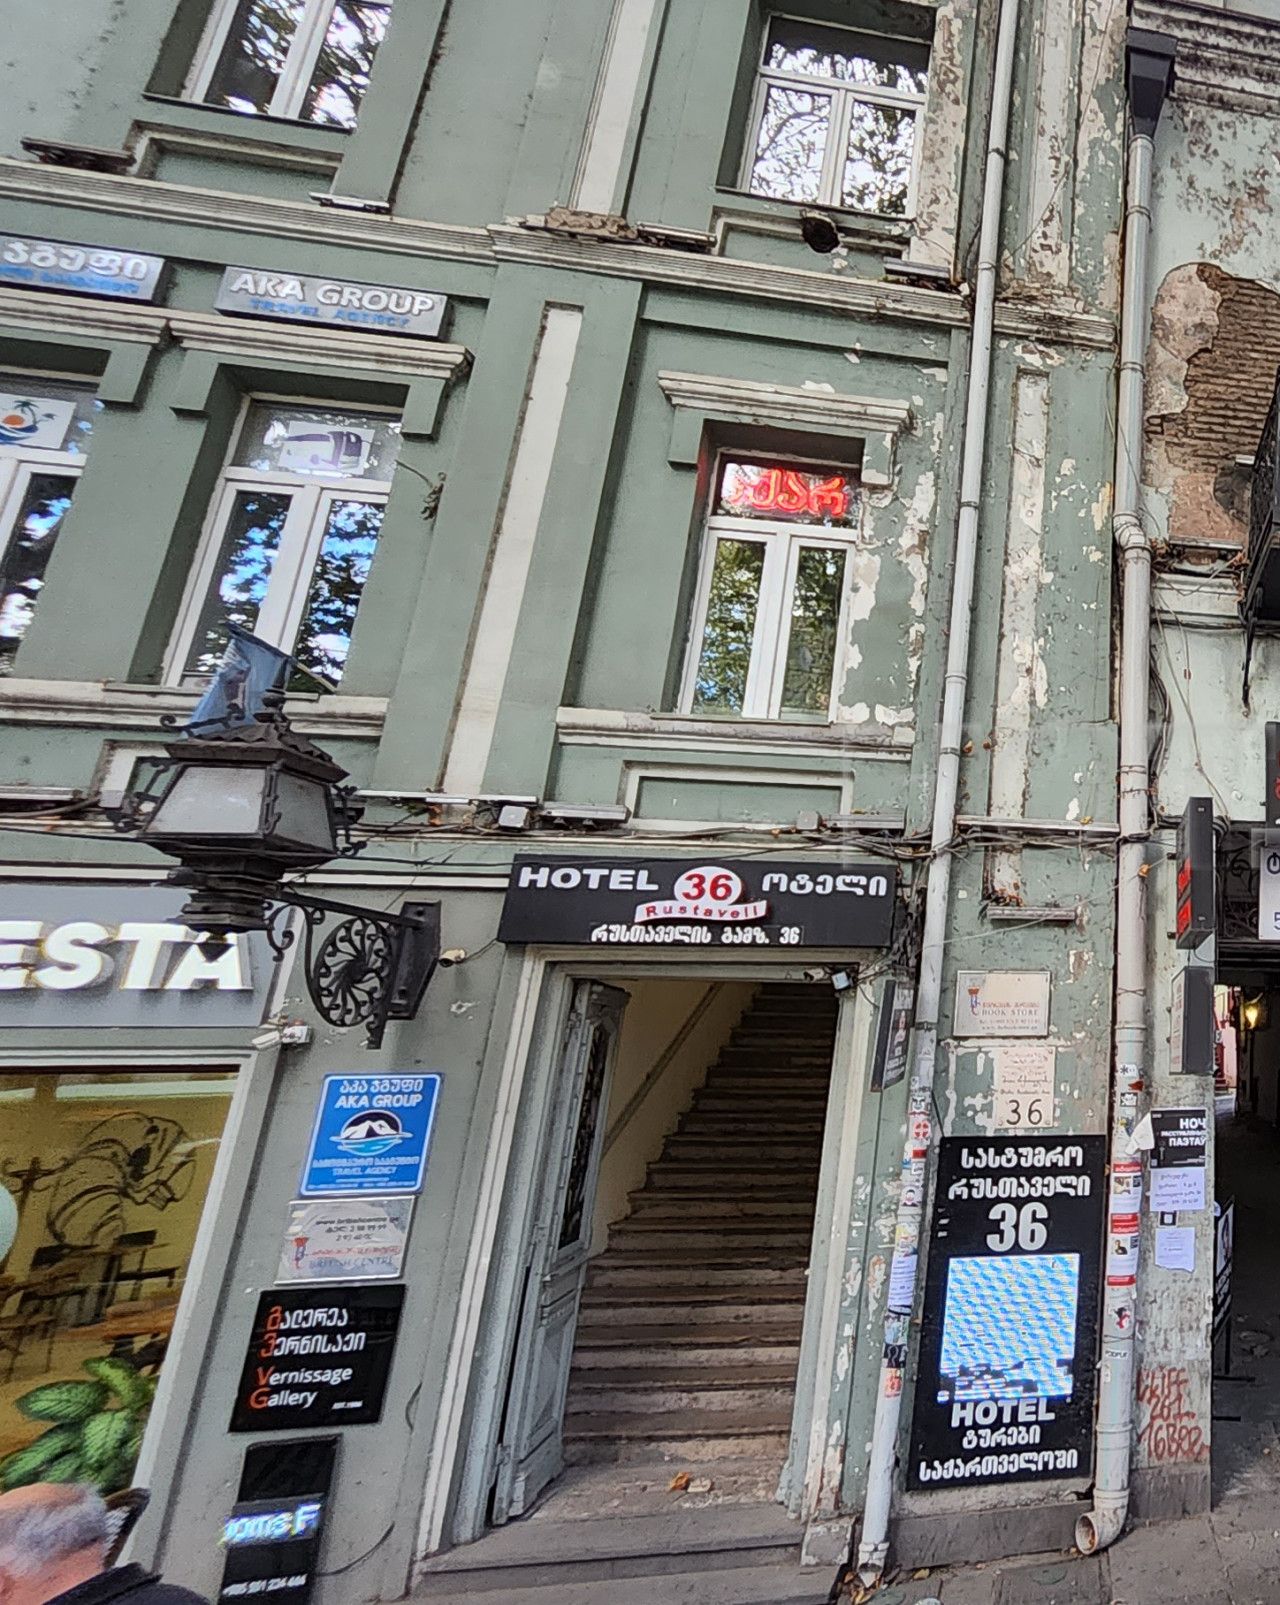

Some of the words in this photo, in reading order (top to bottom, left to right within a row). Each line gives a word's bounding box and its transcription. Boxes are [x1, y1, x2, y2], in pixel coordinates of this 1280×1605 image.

[230, 273, 305, 301] AKA
[316, 284, 435, 317] GROUP
[518, 866, 660, 891] HOTEL
[682, 872, 734, 902] 36
[761, 871, 889, 898] ოტელი
[645, 903, 760, 920] Rustaveli
[590, 923, 712, 945] რუსთაველის
[721, 924, 770, 945] გამზ.
[779, 925, 802, 945] 36
[334, 1094, 369, 1109] AKA
[371, 1093, 423, 1108] GROUP
[1006, 1098, 1043, 1126] 36
[1179, 1117, 1206, 1130] НОЧ
[961, 1146, 1084, 1169] სასტუმრო
[948, 1175, 1092, 1201] რუსთაველი
[986, 1202, 1050, 1252] 36
[267, 1305, 349, 1331] გალერეა
[256, 1366, 354, 1387] Vernissage
[249, 1387, 319, 1410] Gallery
[950, 1398, 1056, 1428] HOTEL
[962, 1425, 1041, 1450] ტურები
[918, 1449, 1079, 1483] საქართველოში
